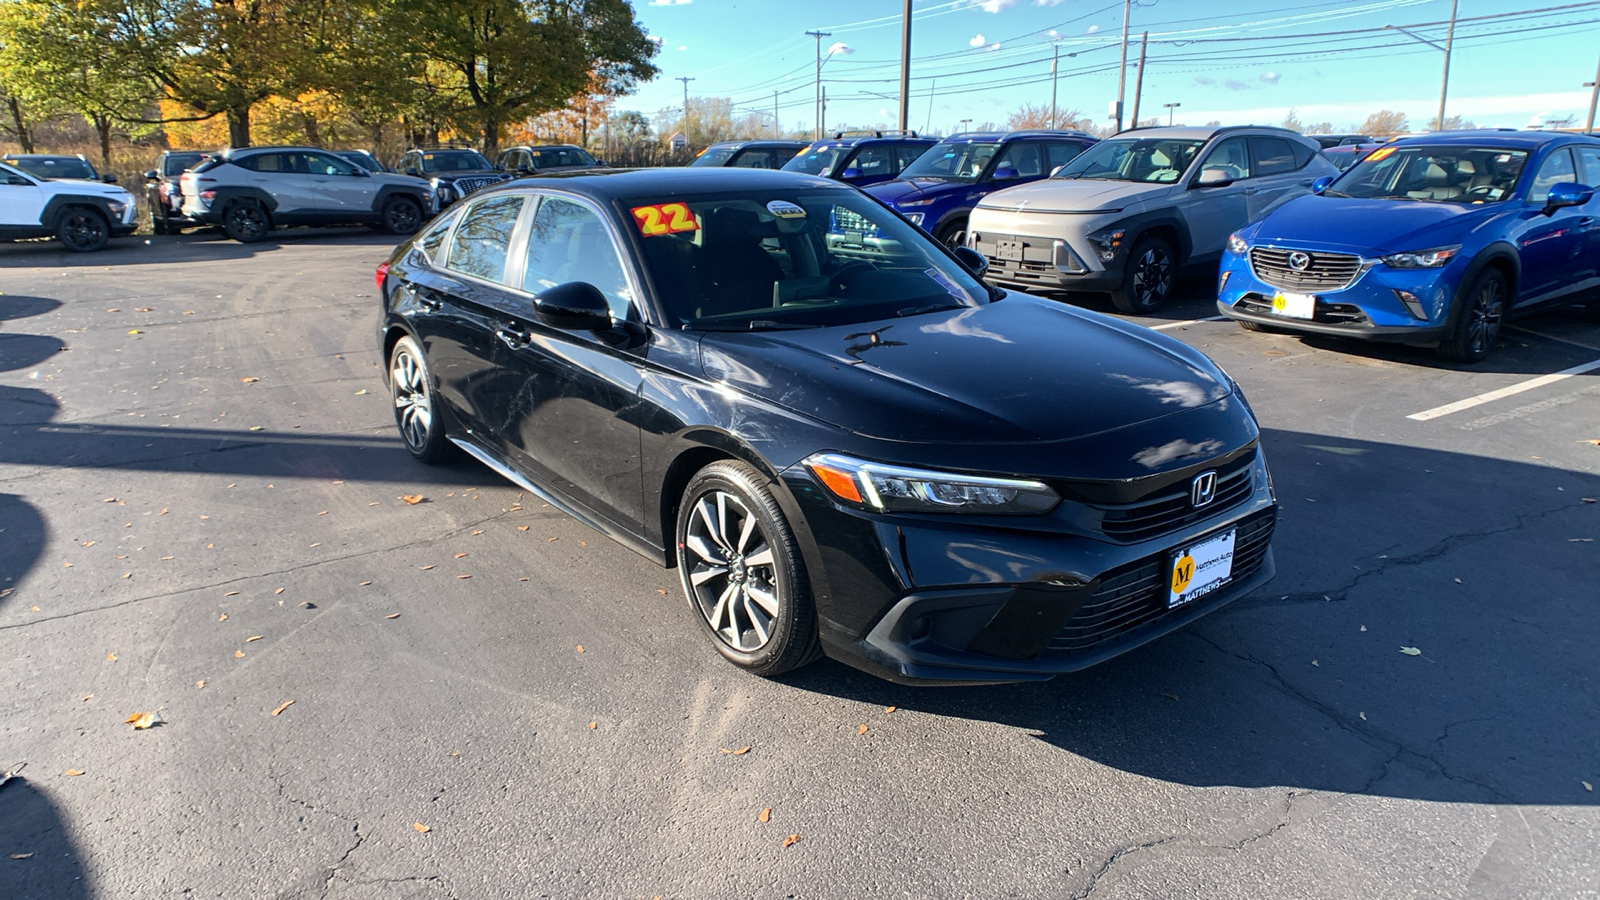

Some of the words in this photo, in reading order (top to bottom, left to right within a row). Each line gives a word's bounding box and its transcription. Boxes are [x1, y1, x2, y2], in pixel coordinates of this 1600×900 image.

[634, 203, 697, 235] 22
[1195, 556, 1219, 571] Matthews
[1220, 551, 1232, 560] Auto
[1174, 562, 1192, 587] M
[1184, 579, 1220, 603] MATTHEWS
